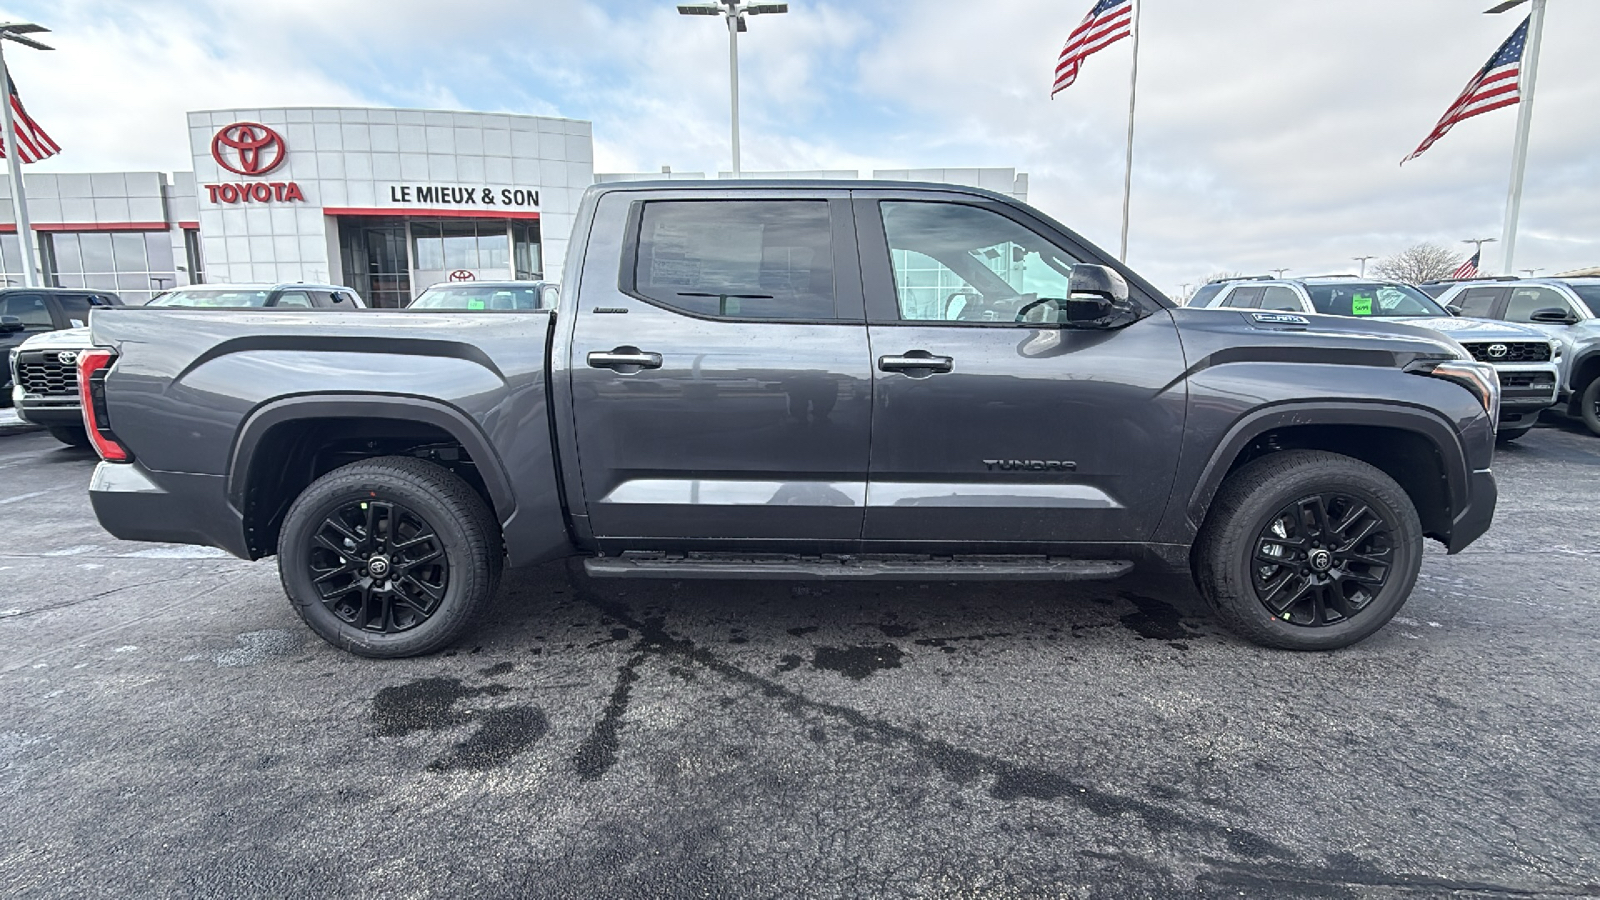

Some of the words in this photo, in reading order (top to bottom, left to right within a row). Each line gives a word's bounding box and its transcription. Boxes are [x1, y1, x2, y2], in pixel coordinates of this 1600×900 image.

[204, 182, 305, 203] TOYOTA
[391, 186, 411, 203] LE
[416, 186, 476, 204] MIEUX
[481, 188, 496, 205] &
[501, 189, 540, 207] SON
[982, 459, 1077, 472] TUNDRA
